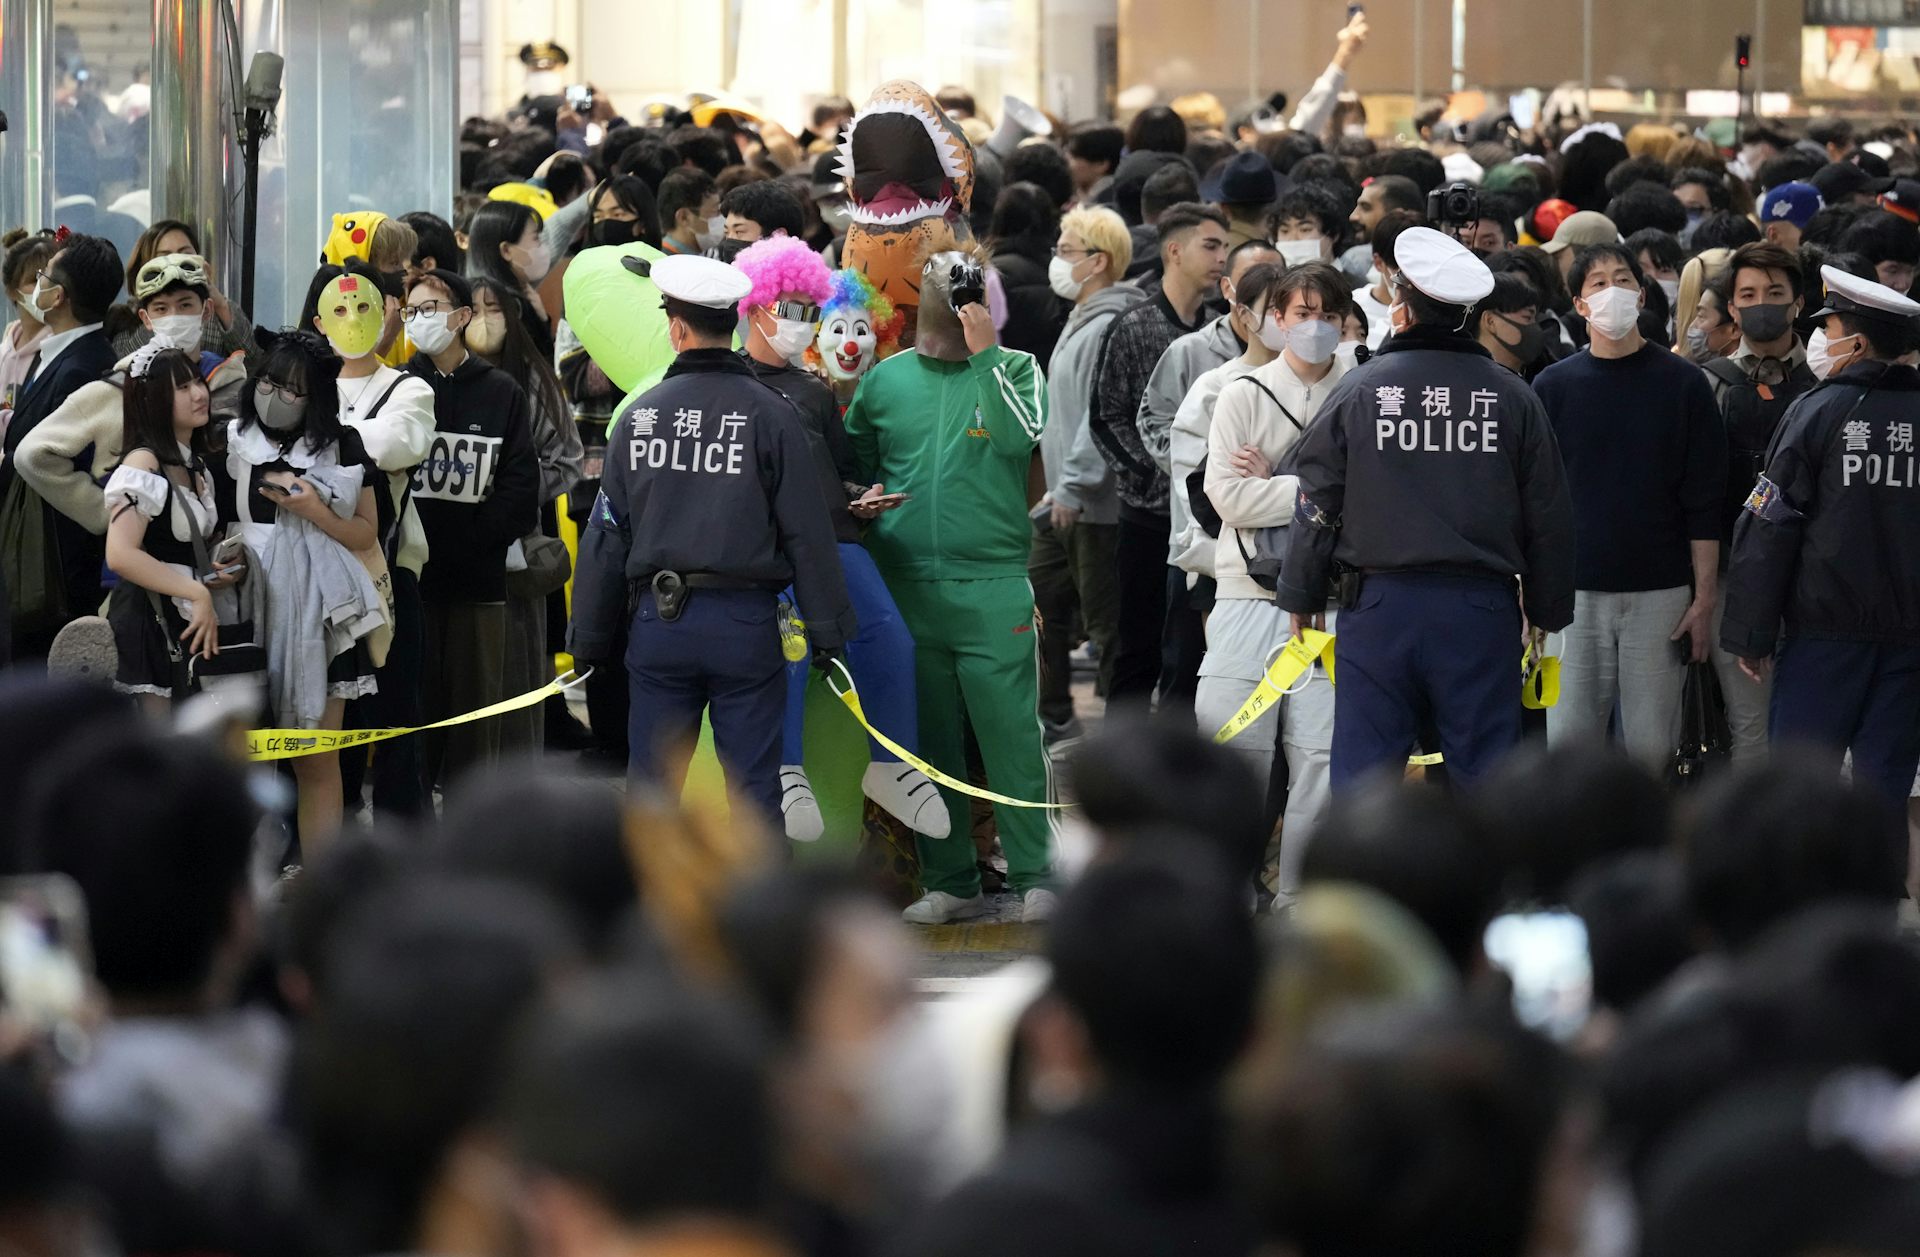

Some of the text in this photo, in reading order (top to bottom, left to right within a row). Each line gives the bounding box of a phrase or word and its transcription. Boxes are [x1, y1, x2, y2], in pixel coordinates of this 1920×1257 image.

[1376, 386, 1498, 418] 警視庁
[631, 408, 747, 441] 警視庁
[1376, 419, 1498, 453] POLICE
[1843, 420, 1914, 452] 警視
[630, 438, 743, 474] POLICE
[1843, 453, 1920, 487] POLI
